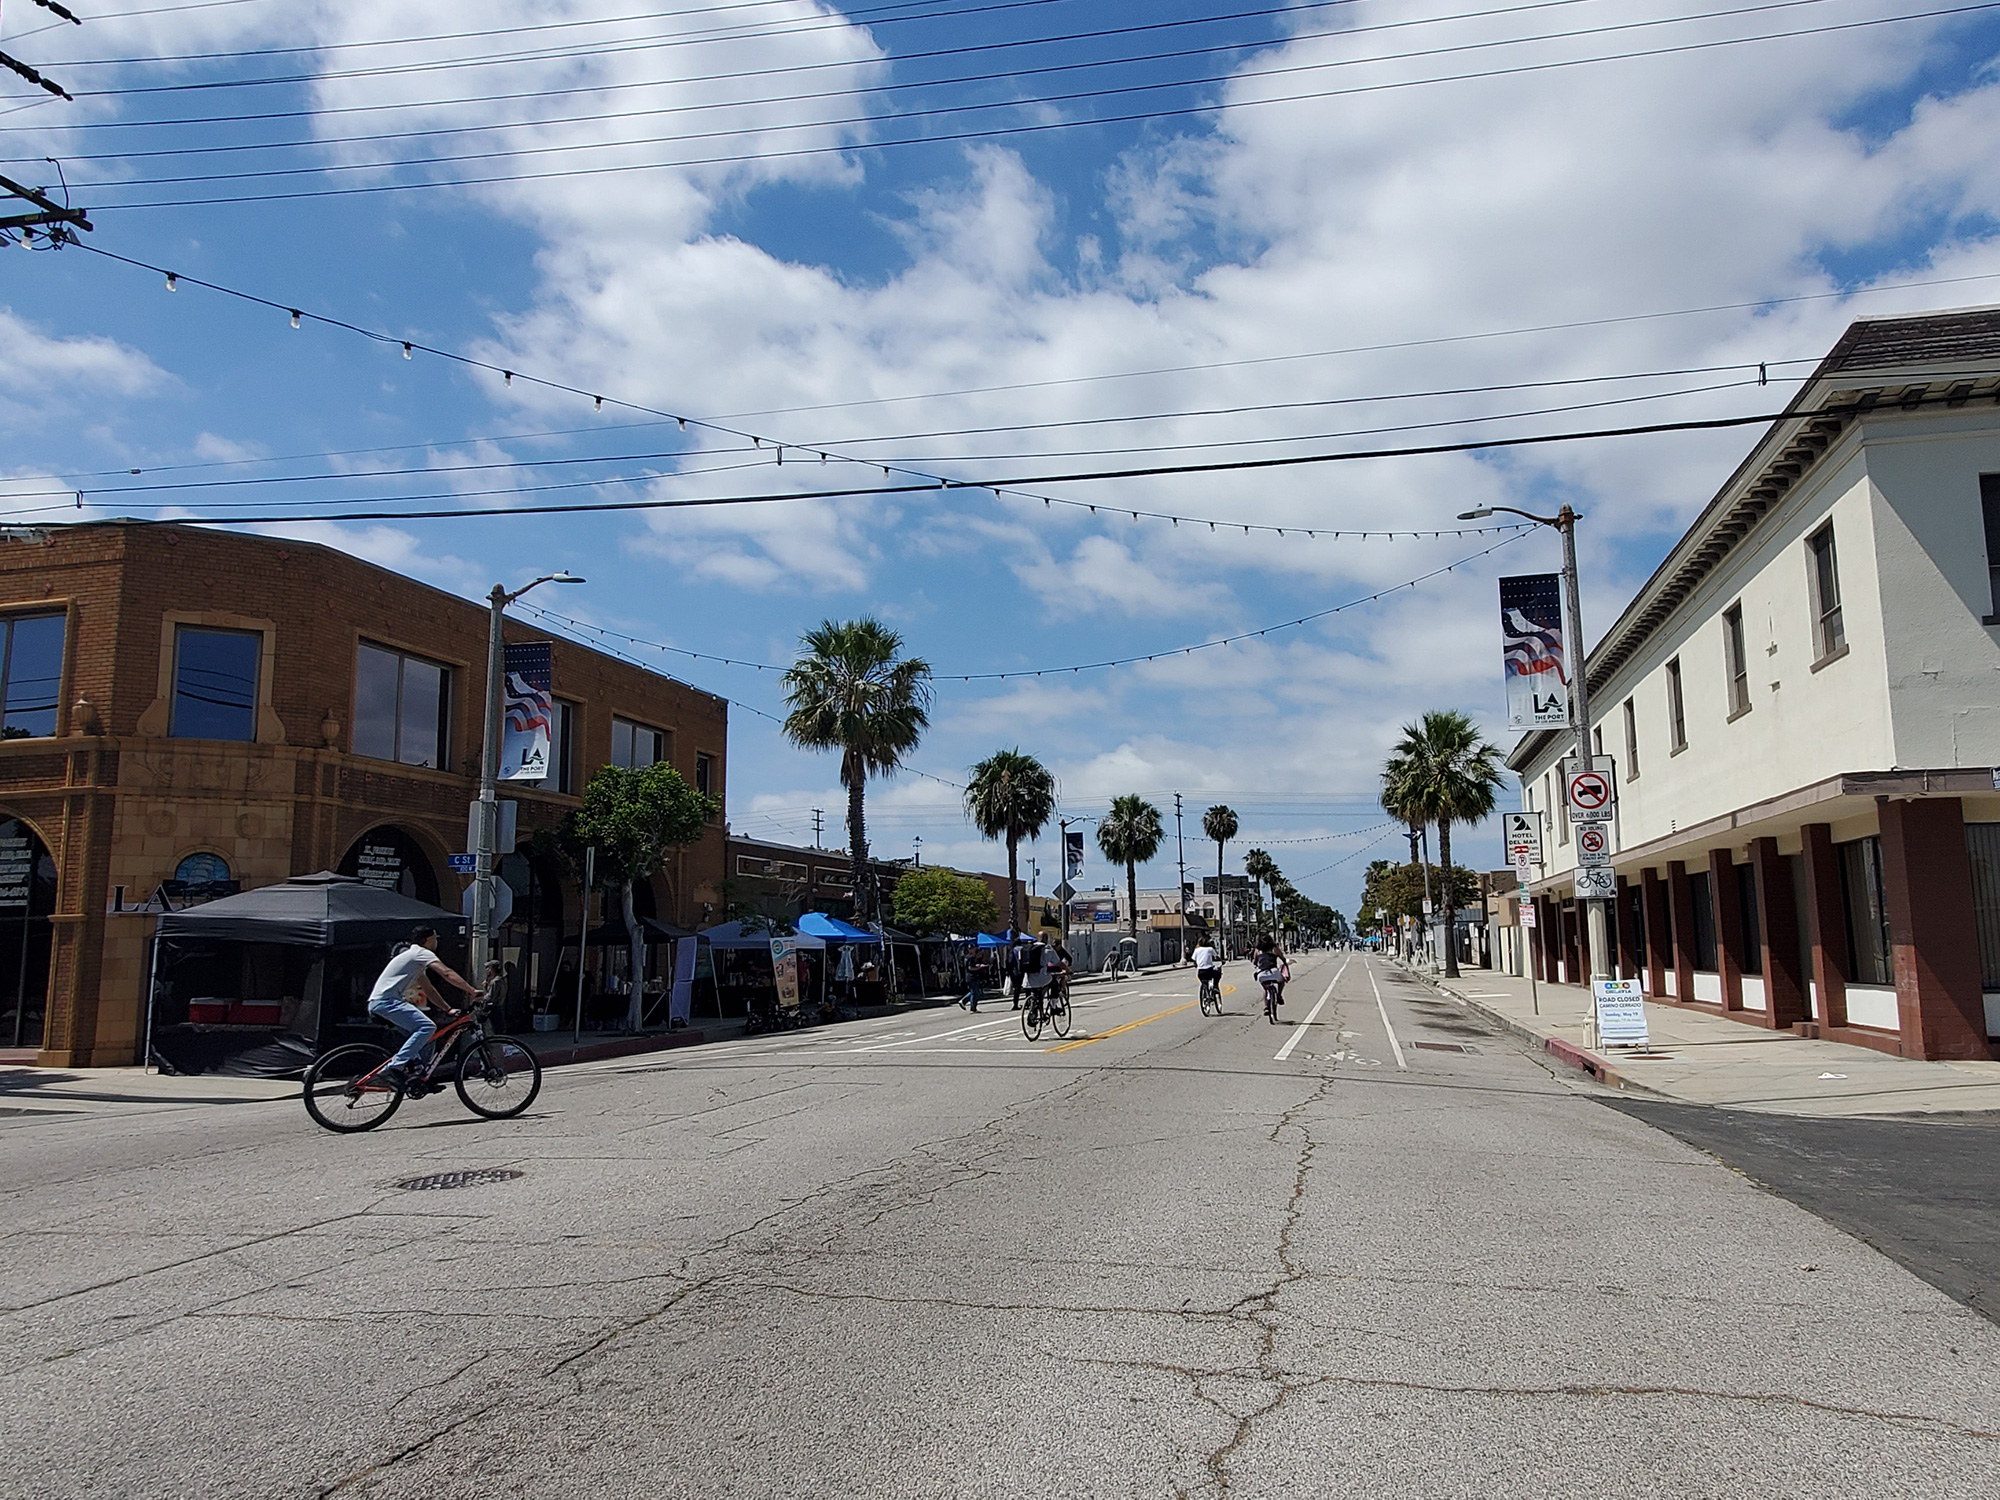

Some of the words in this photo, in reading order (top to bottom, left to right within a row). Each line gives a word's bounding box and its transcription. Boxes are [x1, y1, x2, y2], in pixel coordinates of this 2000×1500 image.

[1533, 693, 1564, 713] LA
[521, 748, 544, 765] LA
[454, 856, 460, 864] C
[462, 856, 470, 864] St
[111, 884, 175, 913] LA
